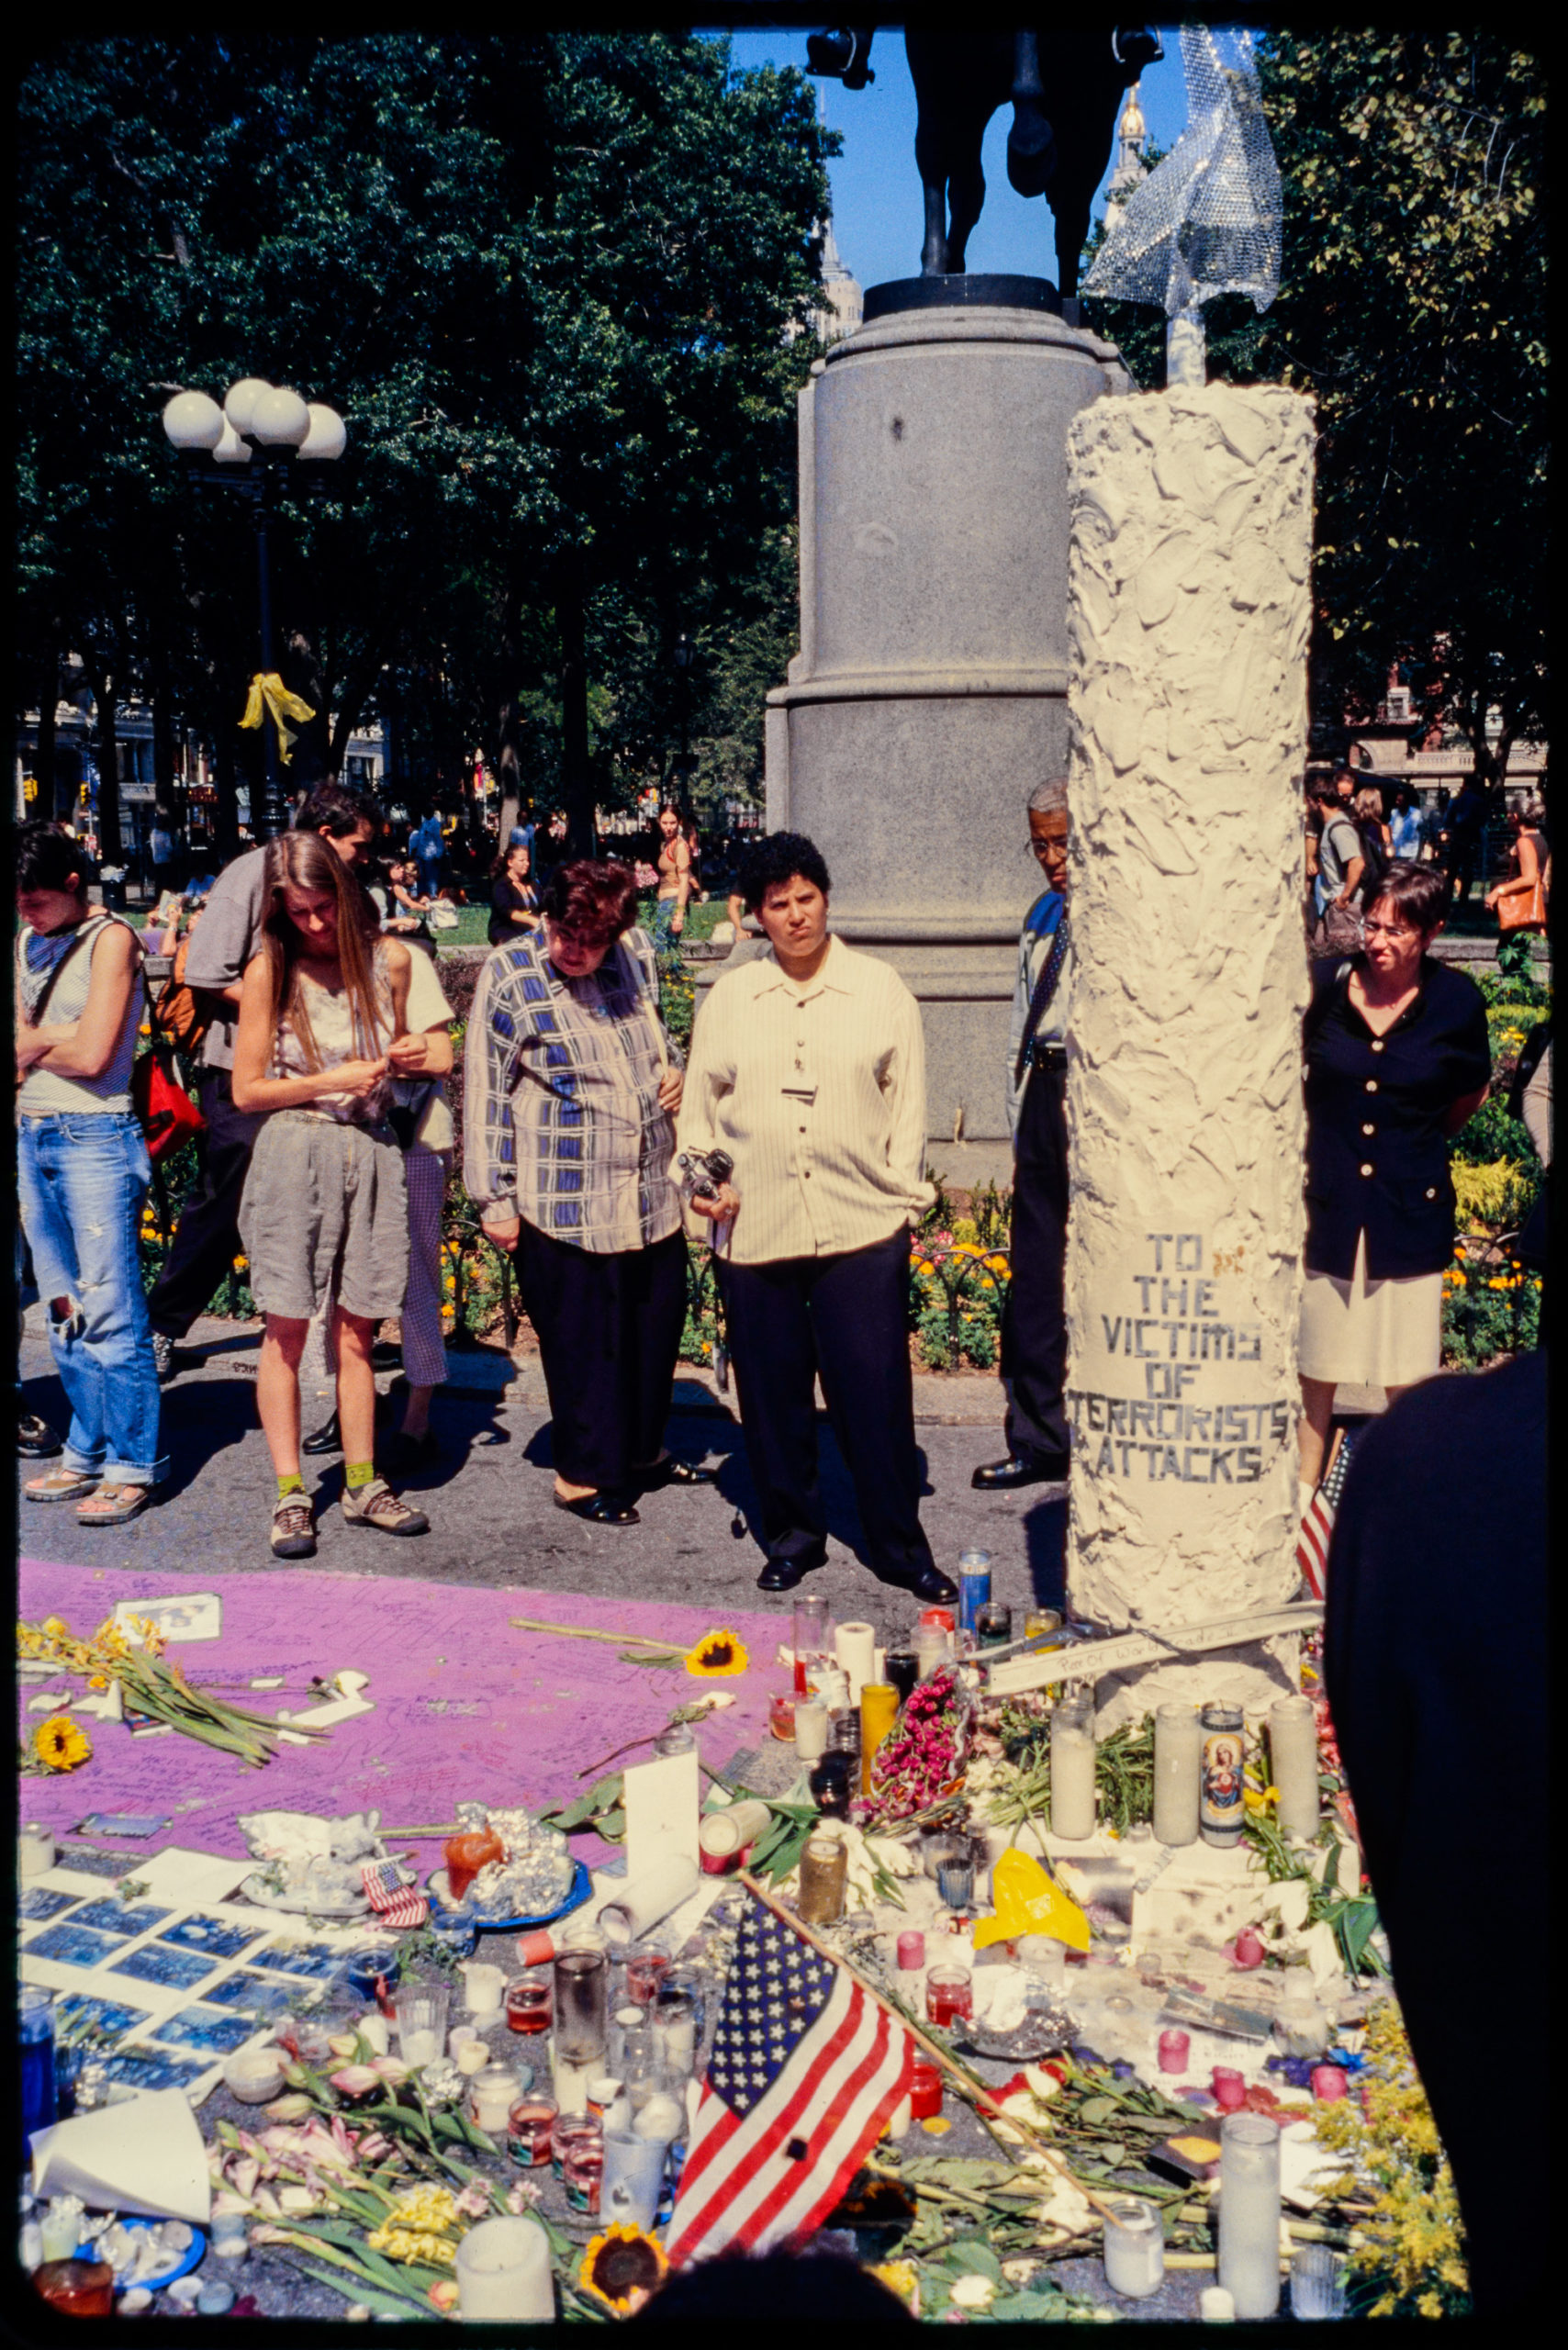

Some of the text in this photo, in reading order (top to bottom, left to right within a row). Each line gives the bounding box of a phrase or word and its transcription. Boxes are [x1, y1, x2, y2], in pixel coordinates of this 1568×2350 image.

[1146, 1234, 1202, 1272] TO
[1133, 1275, 1219, 1316] THE
[1145, 1362, 1201, 1400] OF
[1067, 1388, 1289, 1442] TERRORISTS
[1096, 1435, 1262, 1484] ATTACKS
